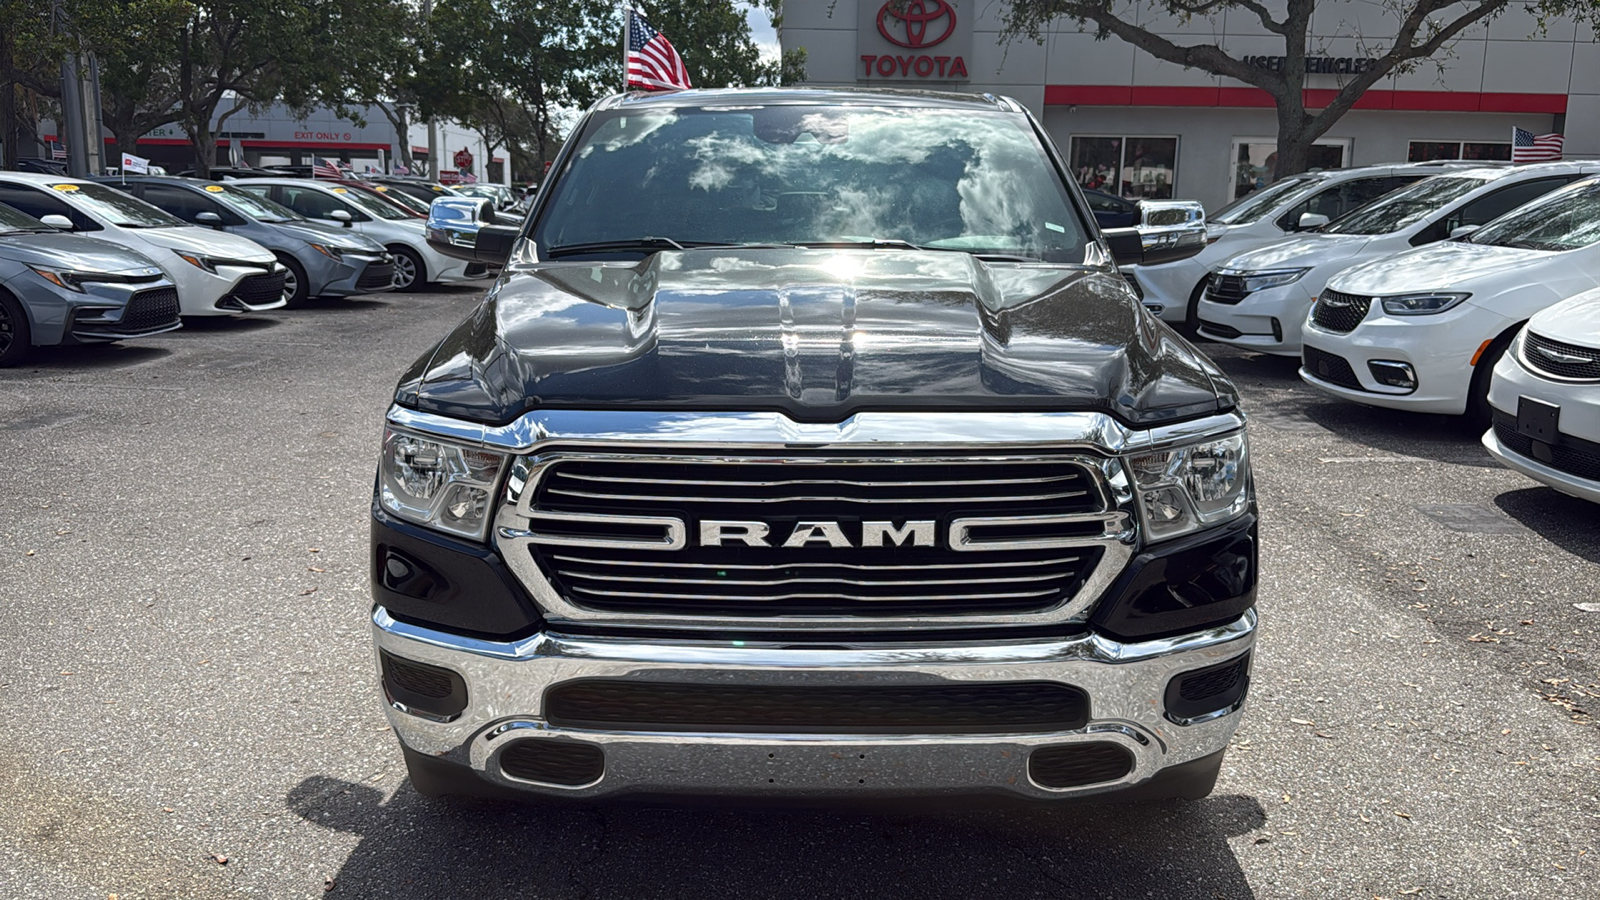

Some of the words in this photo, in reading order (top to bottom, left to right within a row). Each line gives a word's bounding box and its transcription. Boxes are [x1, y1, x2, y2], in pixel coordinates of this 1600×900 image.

[861, 55, 968, 77] TOYOTA
[316, 132, 340, 140] ONLY
[700, 520, 936, 547] RAM
